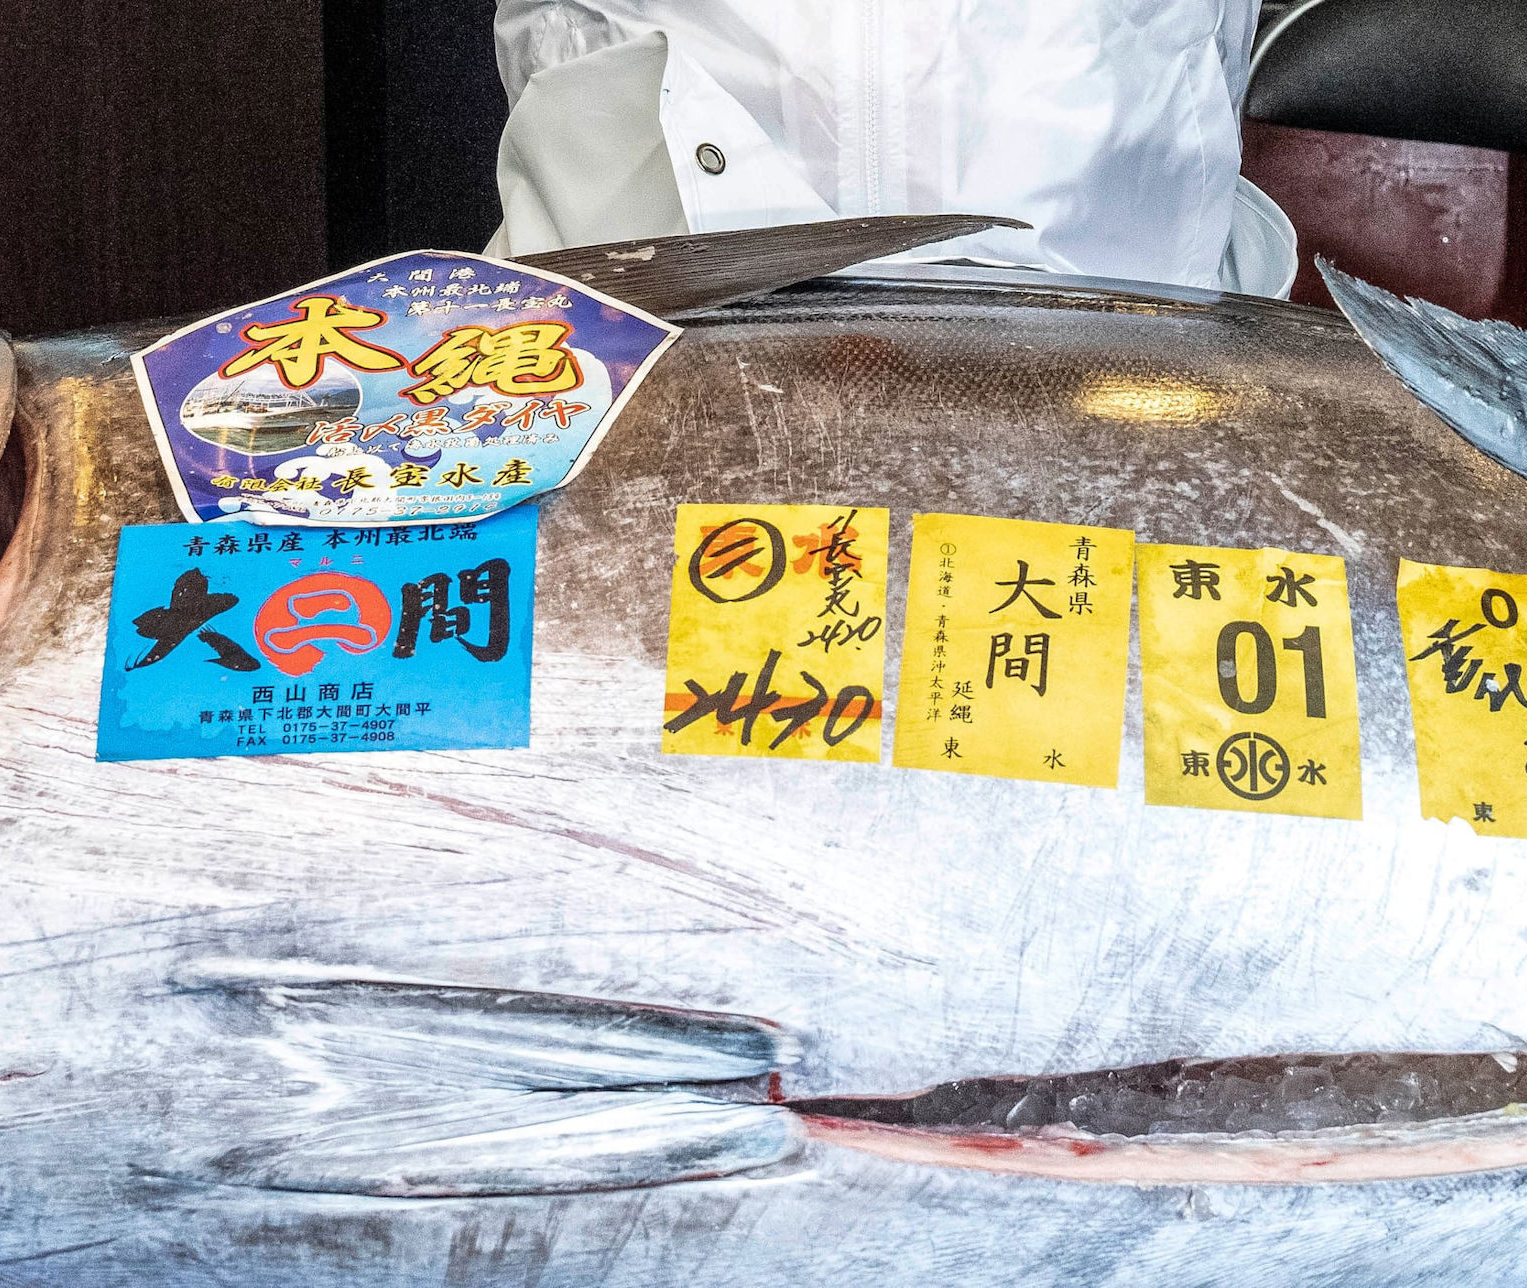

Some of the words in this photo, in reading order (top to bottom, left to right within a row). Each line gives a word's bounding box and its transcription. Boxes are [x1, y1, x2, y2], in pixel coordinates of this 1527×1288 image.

[382, 280, 522, 299] 本州最北端
[333, 458, 535, 495] 長宝水産
[183, 529, 305, 557] 青森県産
[322, 522, 478, 550] 本州最北端
[1066, 535, 1098, 616] 青森県
[985, 558, 1063, 698] 大間
[1216, 619, 1327, 719] 01
[252, 681, 375, 705] 西山商店
[949, 680, 974, 725] 延縄
[198, 701, 432, 725] 青森県下北郡大間町大間平
[237, 724, 266, 735] TEL
[282, 719, 395, 733] 0175-37-4907
[236, 735, 267, 747] FAX
[282, 731, 395, 745] 0175-37-4908
